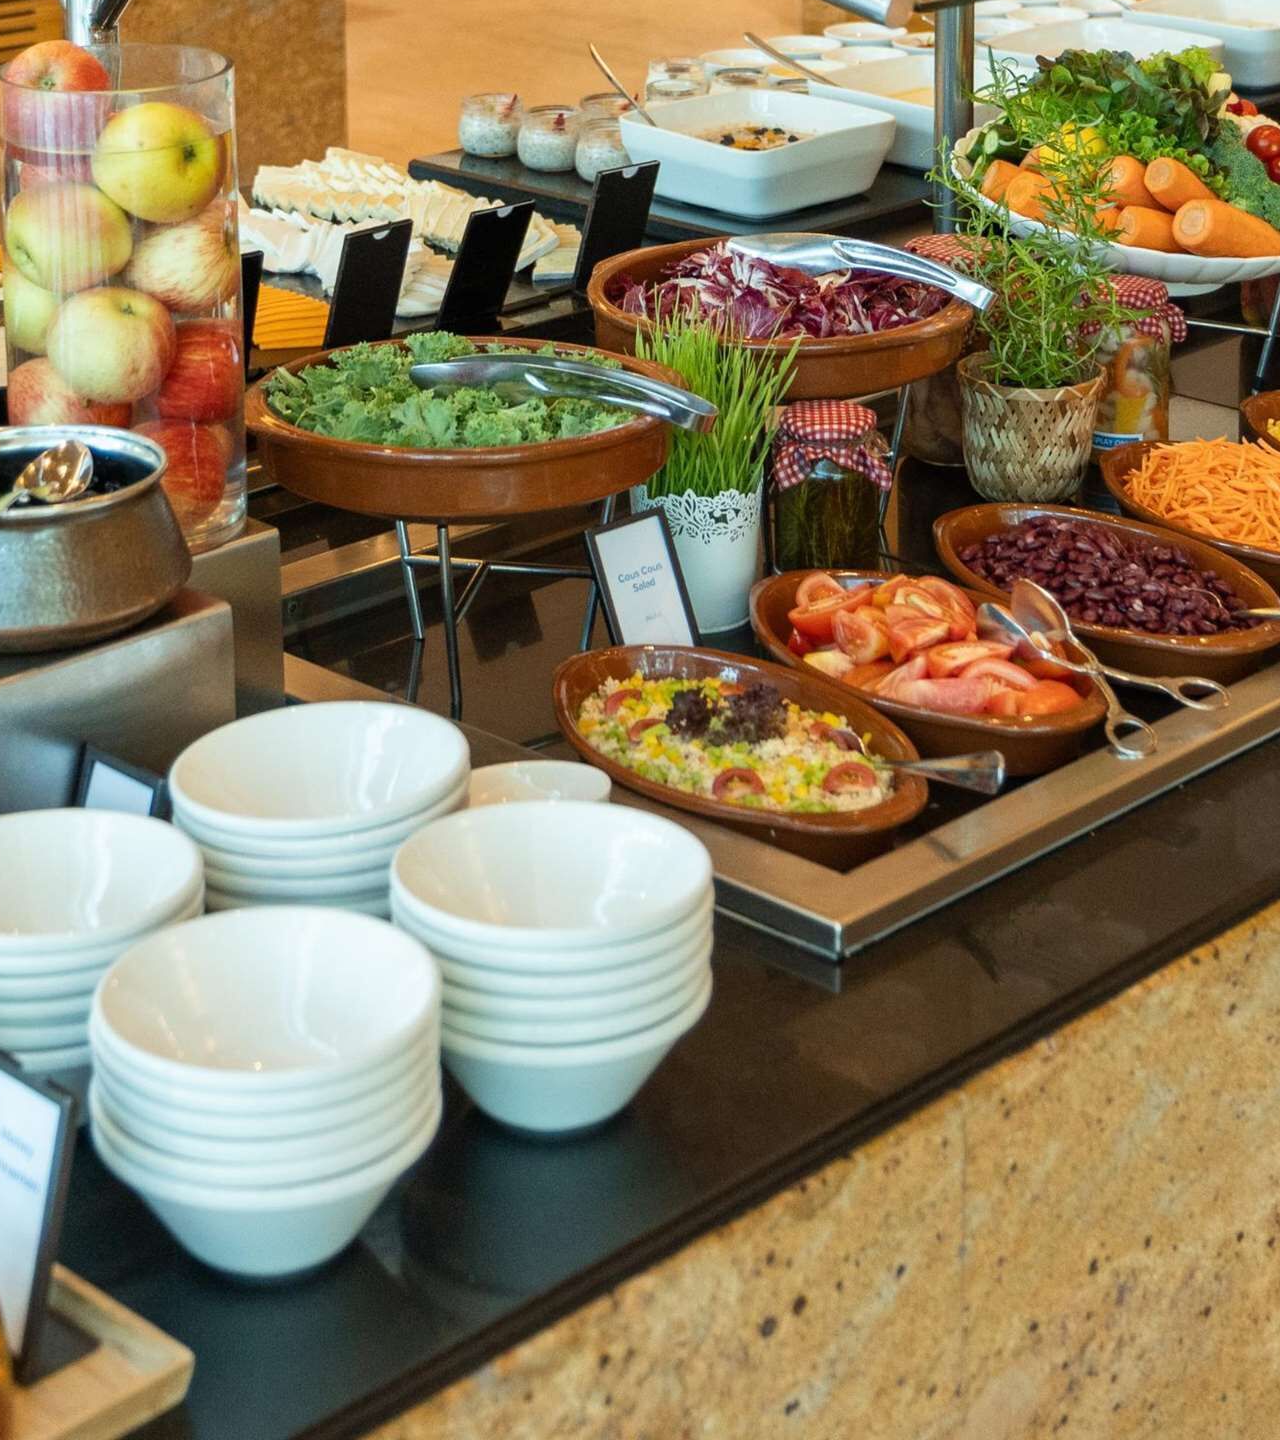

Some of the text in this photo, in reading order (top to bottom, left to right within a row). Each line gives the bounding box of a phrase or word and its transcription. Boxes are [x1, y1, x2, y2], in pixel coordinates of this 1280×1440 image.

[617, 561, 663, 584] Cous Cous
[632, 576, 656, 593] Salad
